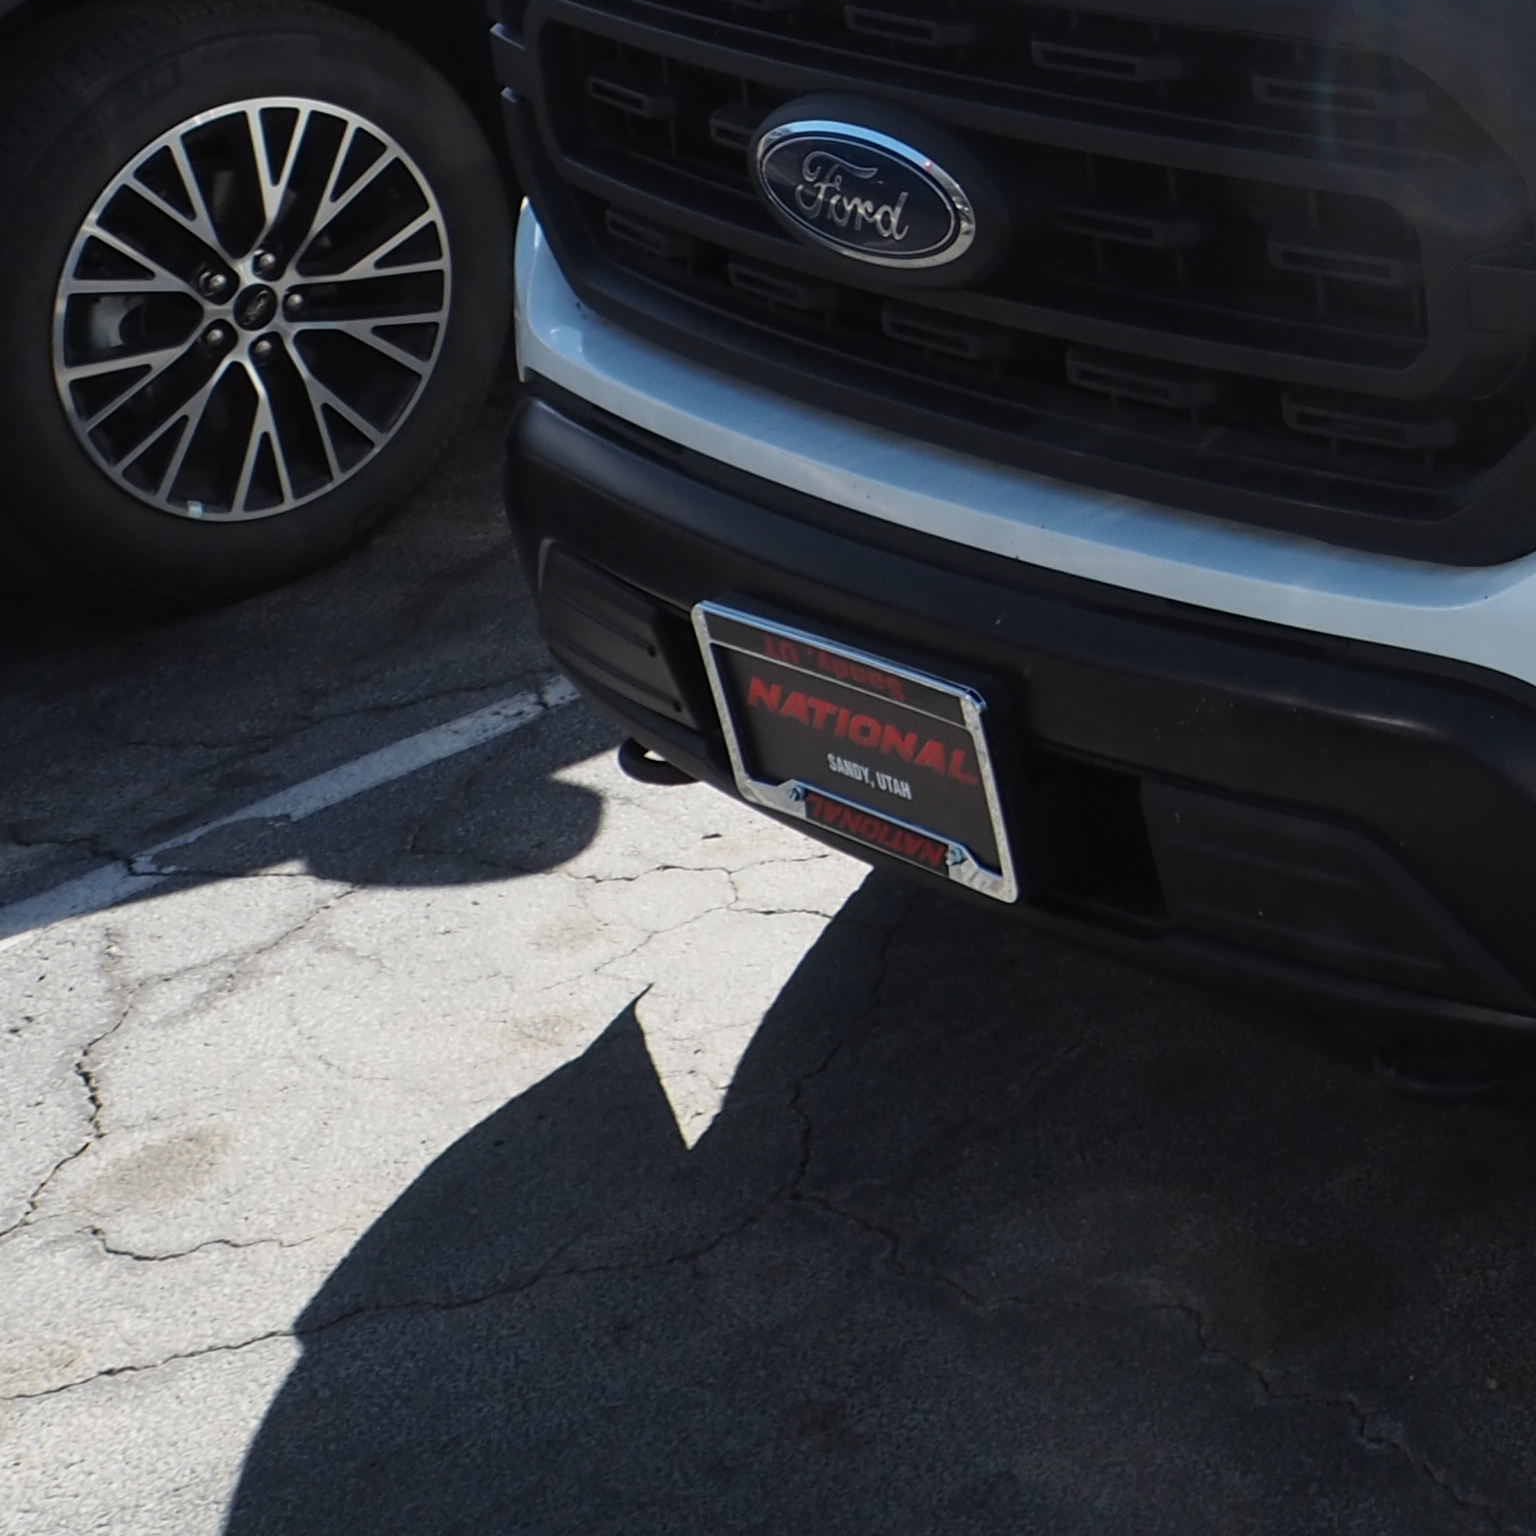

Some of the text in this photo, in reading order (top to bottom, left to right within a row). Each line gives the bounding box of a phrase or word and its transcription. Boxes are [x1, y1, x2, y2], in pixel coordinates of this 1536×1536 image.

[794, 150, 910, 241] Ford
[746, 676, 980, 787] NATIONAL
[827, 752, 912, 801] SANDY, UTAH
[805, 793, 948, 866] NATIONAL
